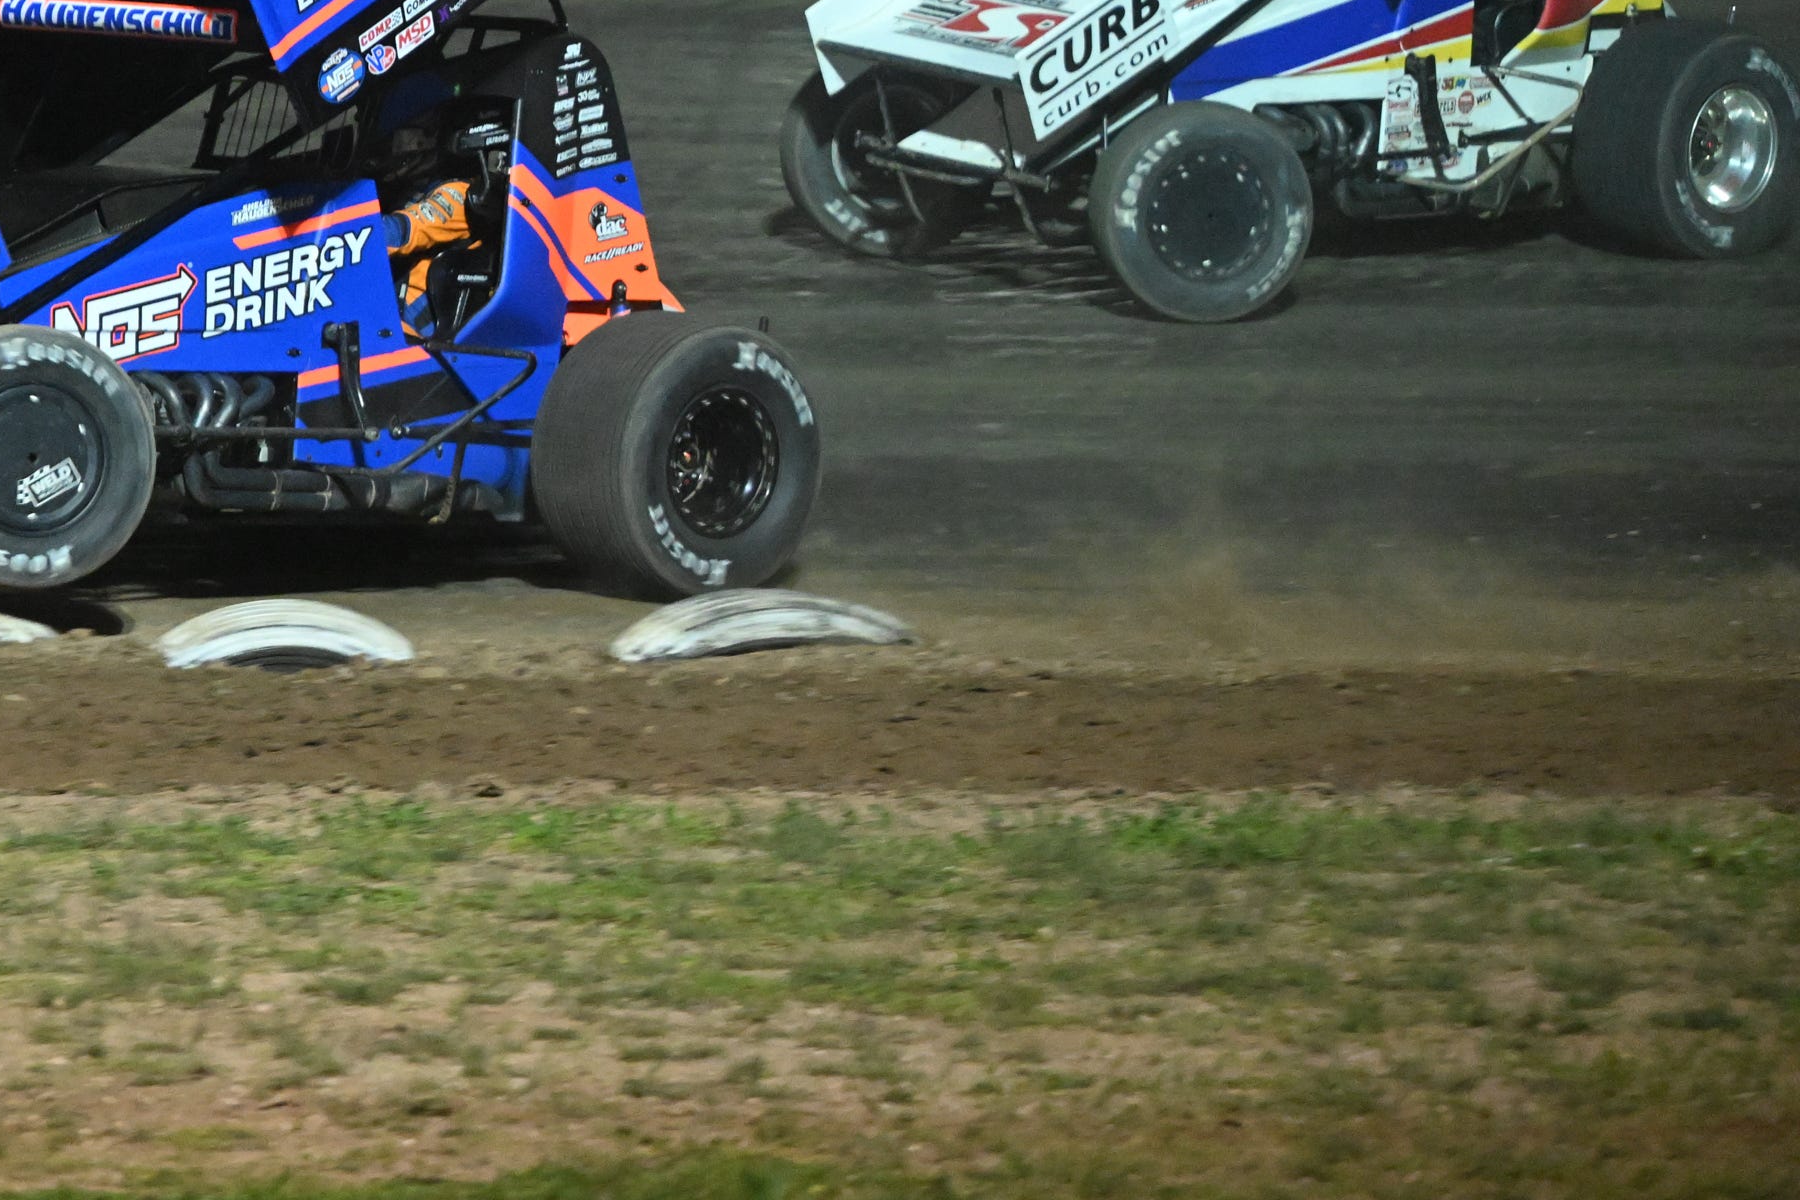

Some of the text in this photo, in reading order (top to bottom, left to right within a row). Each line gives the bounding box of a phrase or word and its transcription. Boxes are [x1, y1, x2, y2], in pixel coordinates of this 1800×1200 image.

[361, 17, 392, 48] COMP
[398, 15, 431, 48] MSD
[326, 57, 356, 92] NOS
[366, 43, 385, 71] VP
[1043, 33, 1169, 128] curb.com
[596, 215, 626, 238] dac
[204, 226, 373, 304] ENERGY
[52, 263, 198, 362] NOS
[202, 273, 334, 339] DRINK
